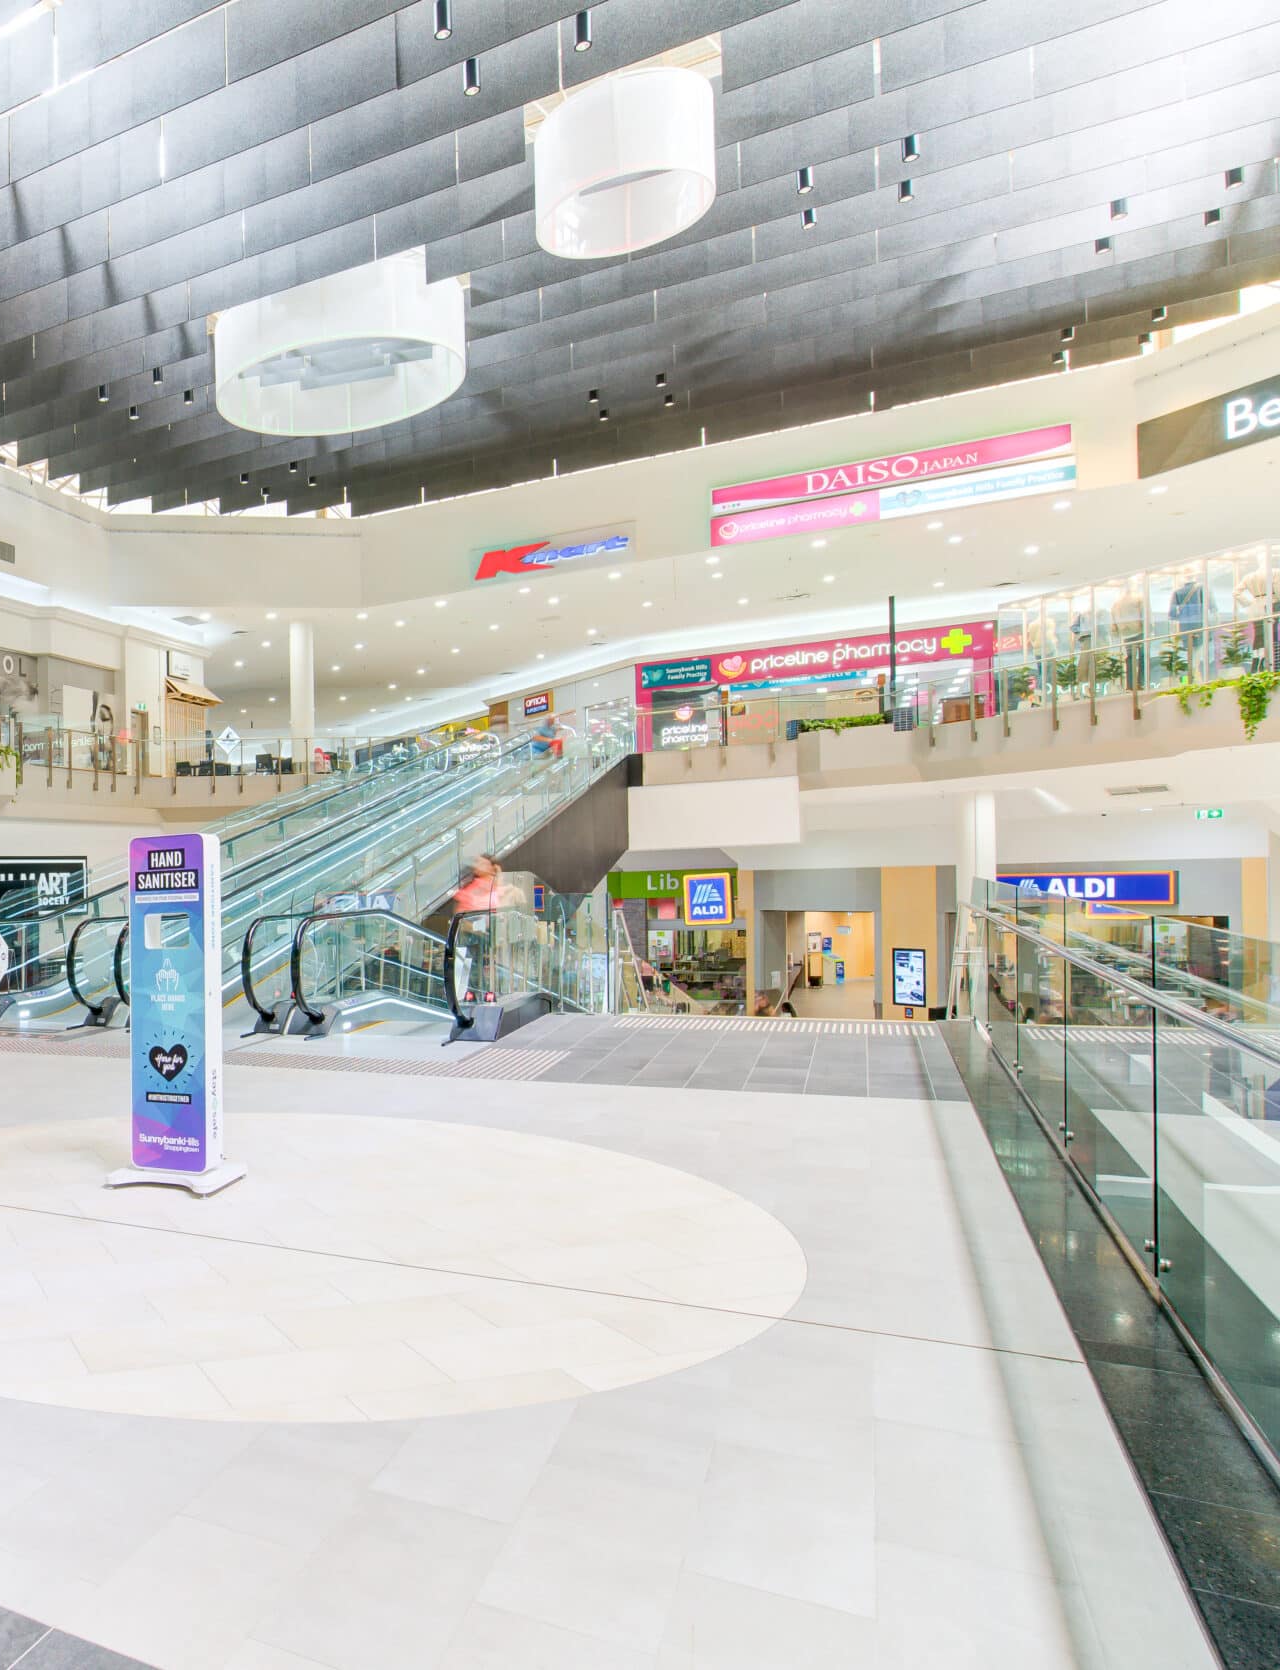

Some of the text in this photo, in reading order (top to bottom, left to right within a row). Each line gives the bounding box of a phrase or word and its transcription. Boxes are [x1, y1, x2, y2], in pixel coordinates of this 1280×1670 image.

[805, 452, 978, 494] DAISO JAPAN
[787, 506, 848, 526] pharmacy
[475, 536, 628, 580] Kmart
[751, 636, 937, 674] priceline pharmacy
[525, 695, 546, 708] OPTICAL
[662, 724, 707, 738] priceline
[662, 734, 708, 747] pharmacy
[151, 851, 182, 868] HAND
[137, 871, 195, 889] SANITISER
[647, 873, 679, 891] Lib
[1047, 877, 1115, 898] ALDI
[692, 905, 724, 915] ALDI
